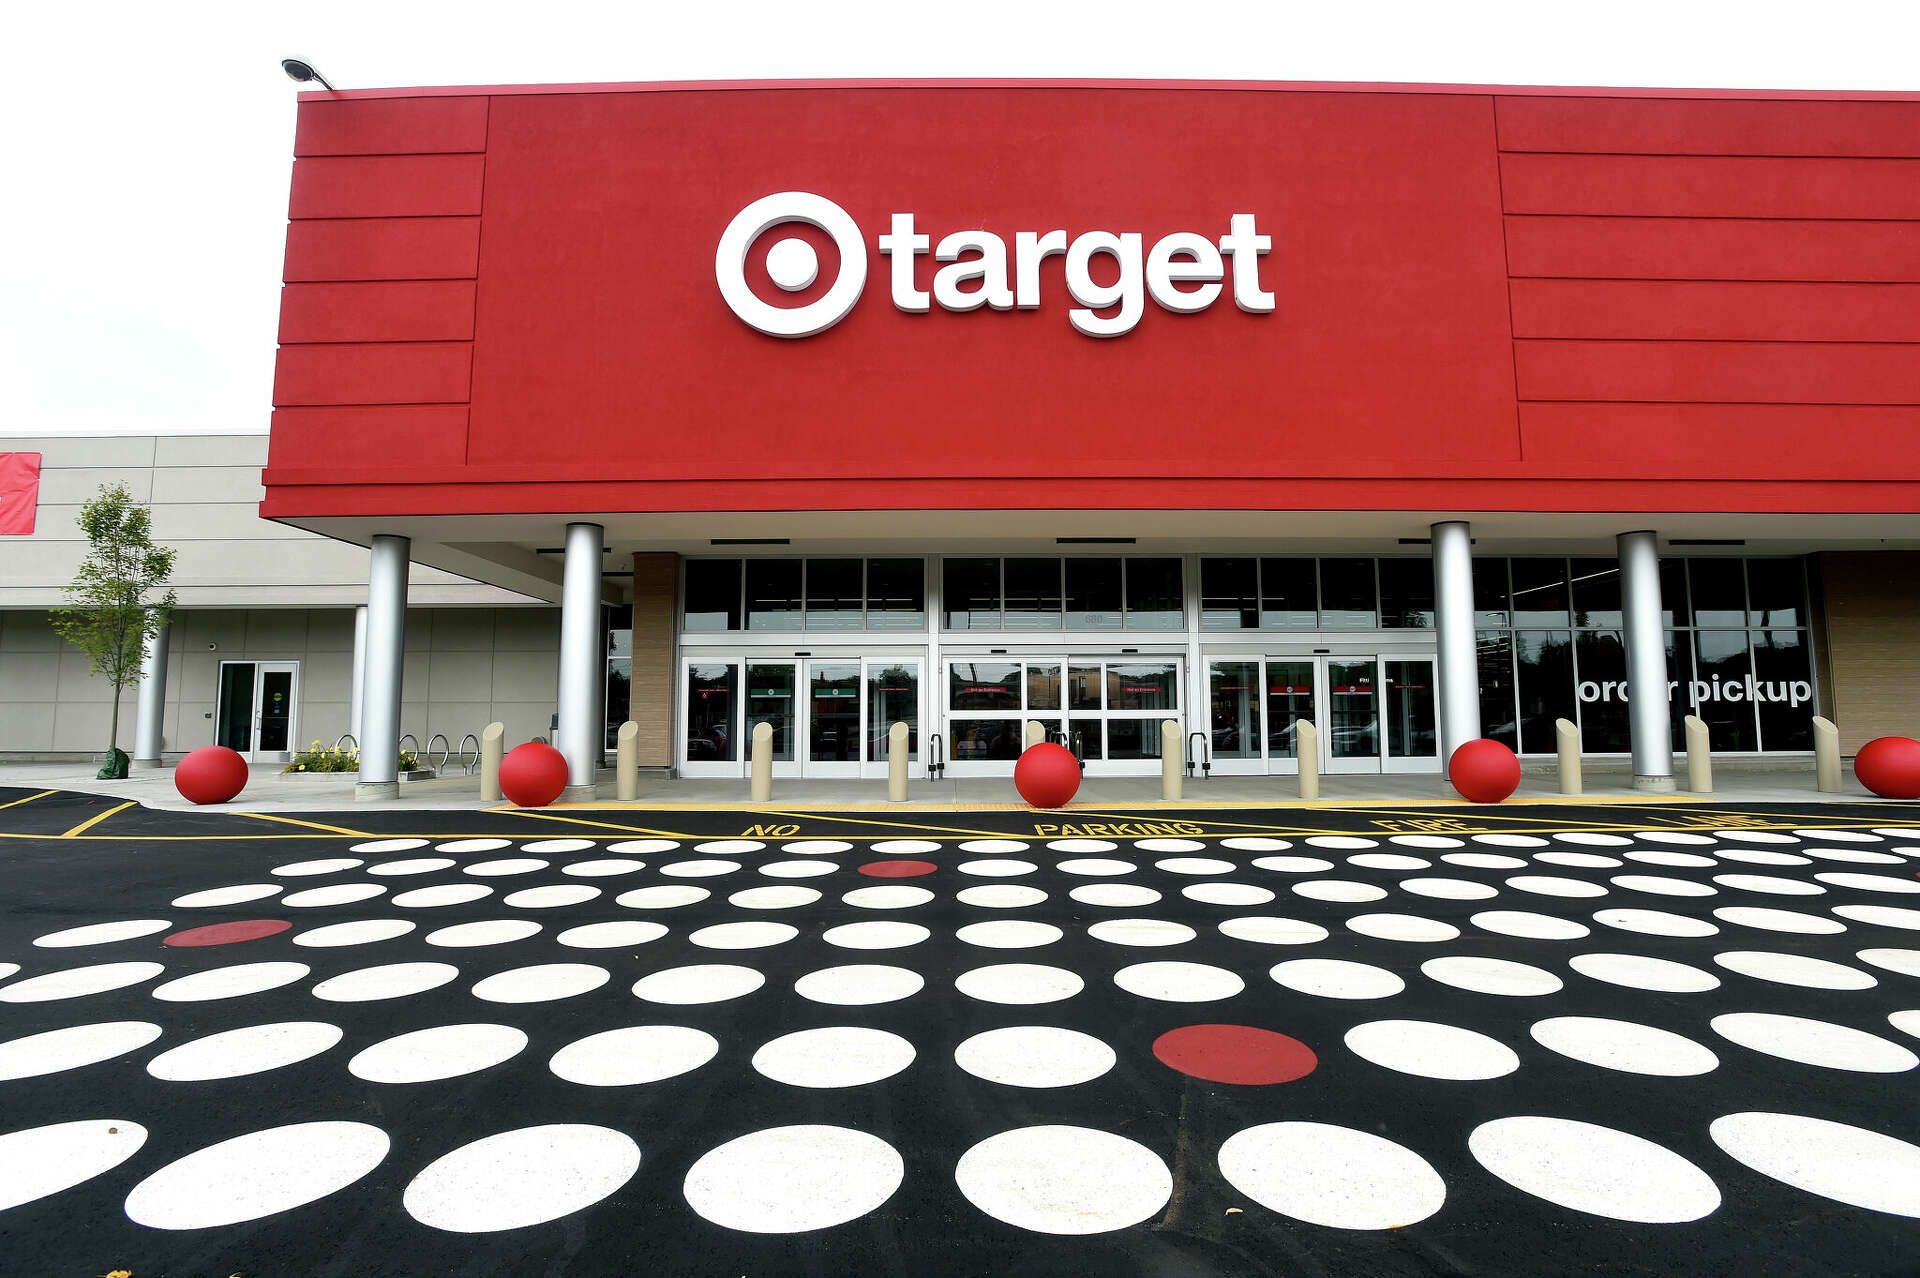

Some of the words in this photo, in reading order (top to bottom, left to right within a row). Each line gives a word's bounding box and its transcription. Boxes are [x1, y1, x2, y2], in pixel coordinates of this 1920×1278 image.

[878, 212, 1276, 338] target
[1578, 680, 1679, 702] orr
[1689, 673, 1812, 708] pickup
[741, 824, 800, 836] NO
[1034, 822, 1204, 836] PARKING
[1368, 819, 1488, 832] FIRE
